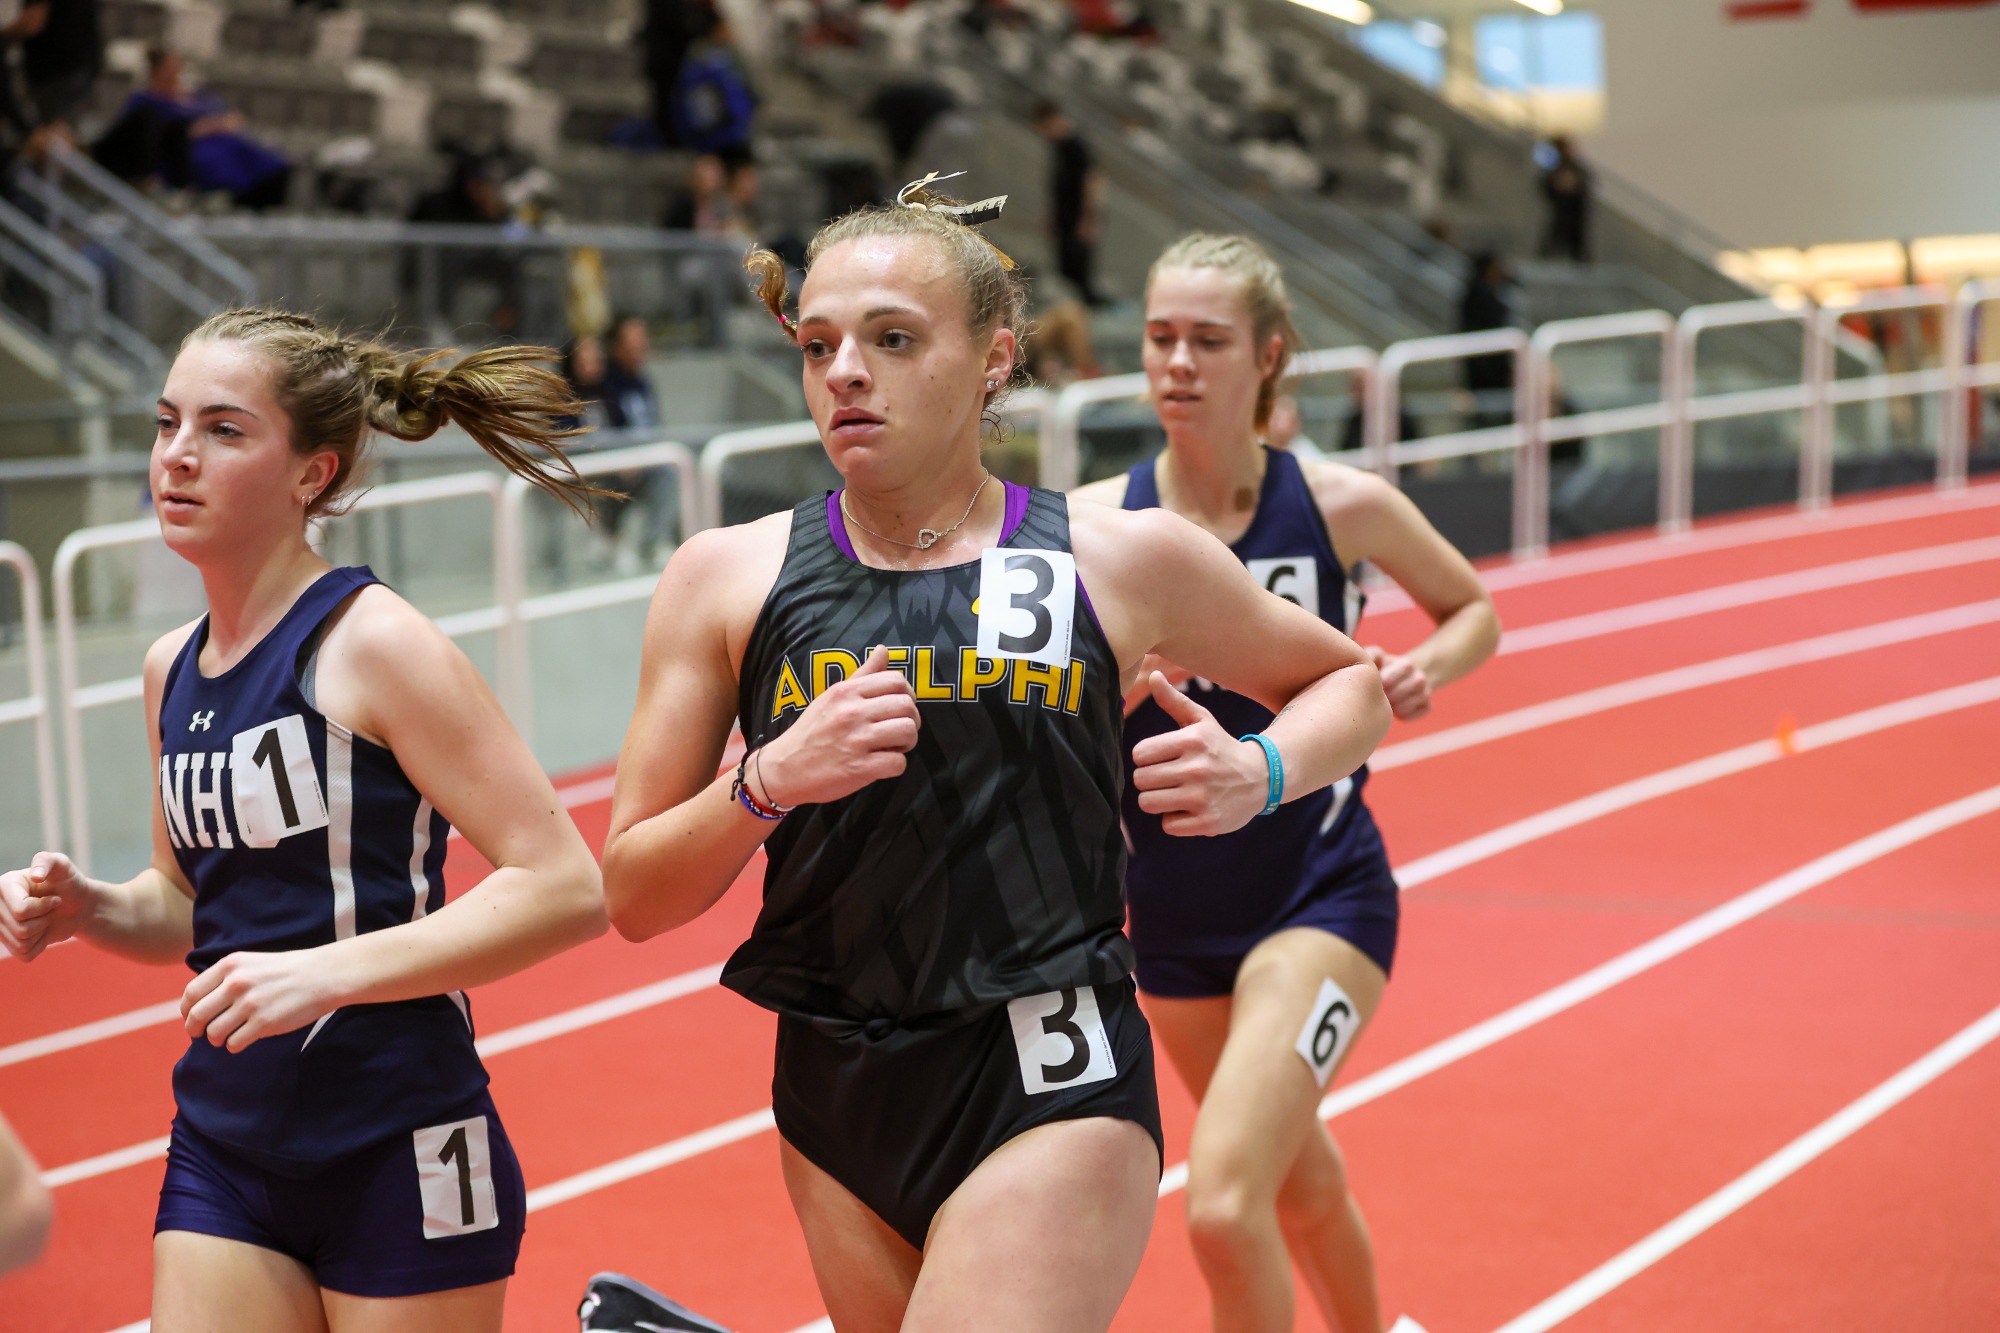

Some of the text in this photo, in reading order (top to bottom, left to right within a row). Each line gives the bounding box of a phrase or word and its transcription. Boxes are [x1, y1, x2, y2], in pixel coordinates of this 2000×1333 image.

[997, 554, 1055, 654] 3
[252, 727, 301, 829] 1
[1041, 987, 1091, 1083] 3
[1312, 1001, 1351, 1069] 6
[437, 1126, 475, 1226] 1
